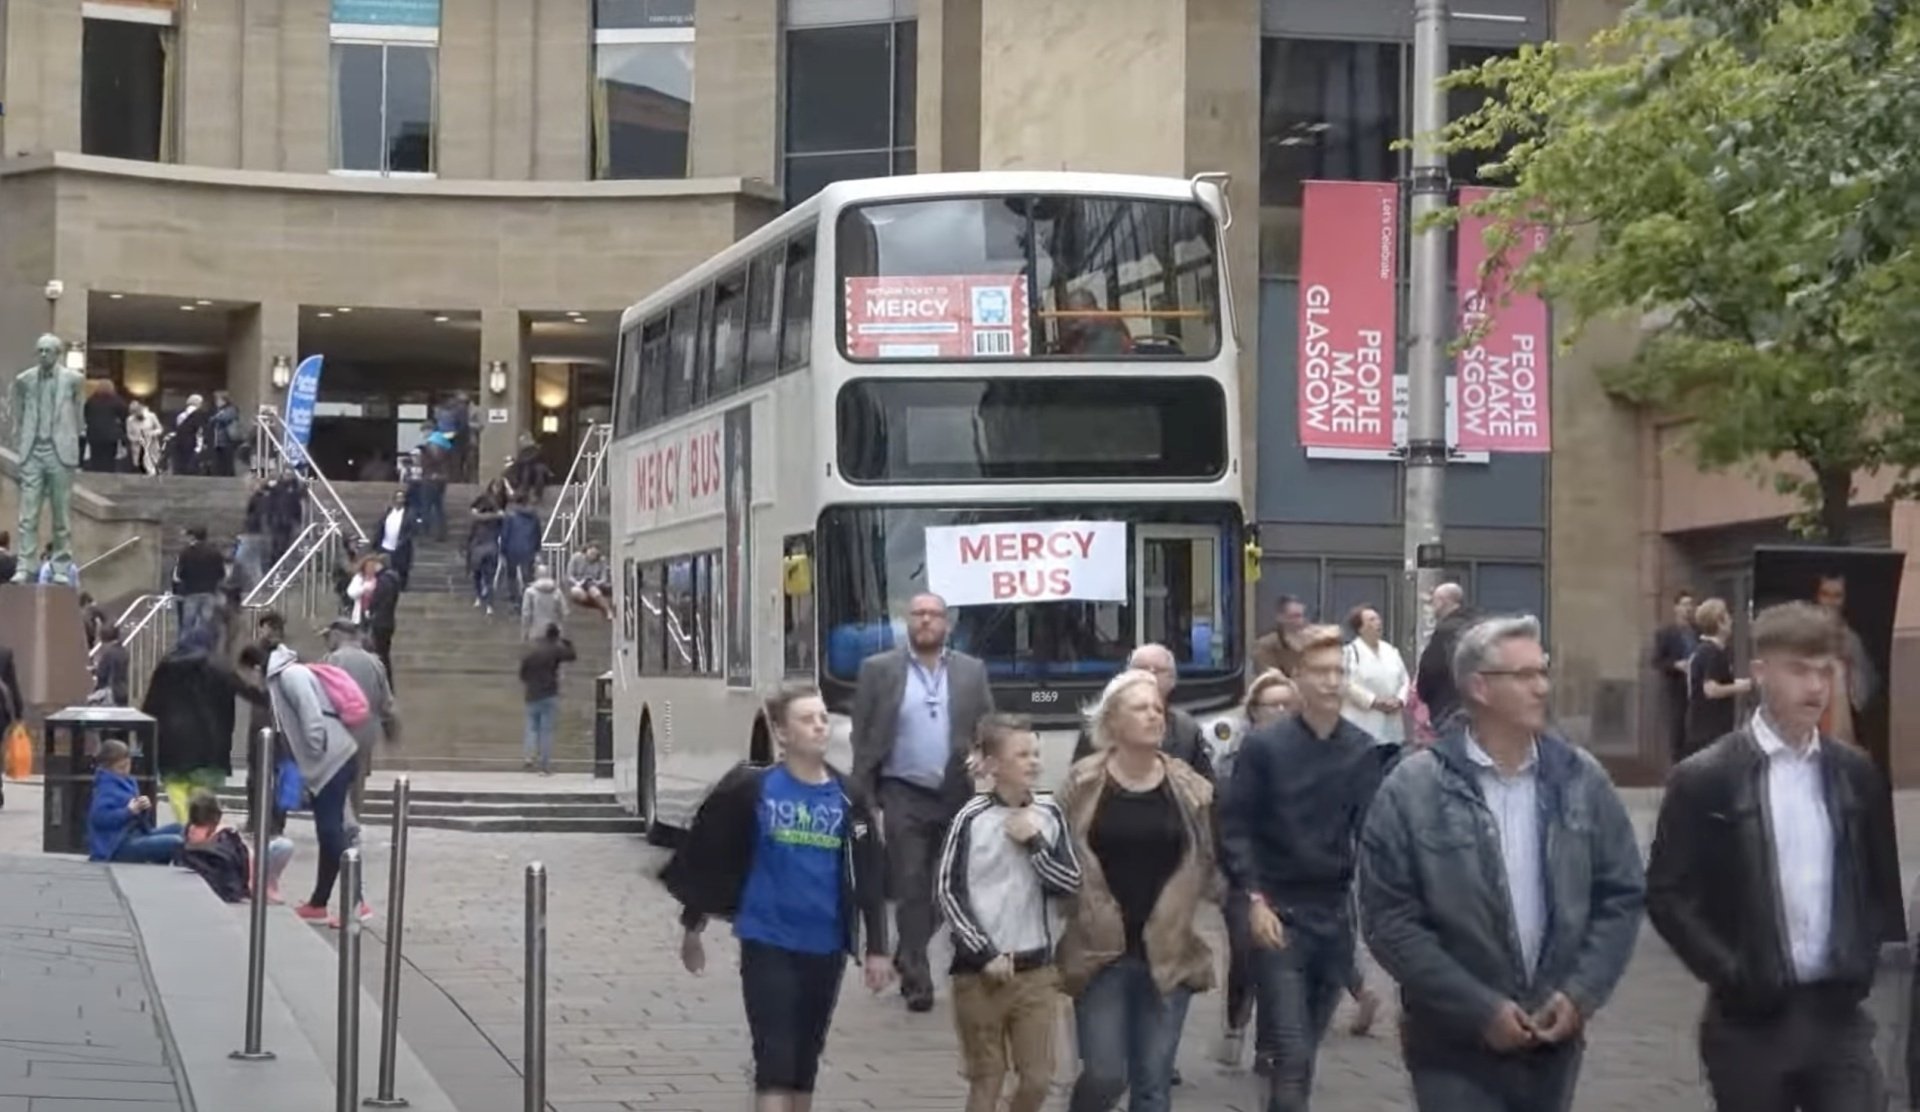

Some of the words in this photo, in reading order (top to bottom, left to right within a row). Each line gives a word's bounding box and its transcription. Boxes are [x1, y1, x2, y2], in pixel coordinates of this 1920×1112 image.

[1380, 226, 1392, 279] Celebrate
[866, 299, 949, 318] MERCY
[1305, 285, 1330, 432] GLASGOW
[1331, 352, 1355, 433] MAKE
[1357, 330, 1381, 434] PEOPLE
[1463, 289, 1486, 436] GLSGOW
[1488, 356, 1512, 437] MAKE
[1512, 335, 1537, 437] PEOPLE
[637, 442, 682, 513] MERCY
[691, 430, 720, 498] BUS
[960, 531, 1095, 564] MERCY
[992, 569, 1072, 600] BUS
[1031, 691, 1059, 702] 18369
